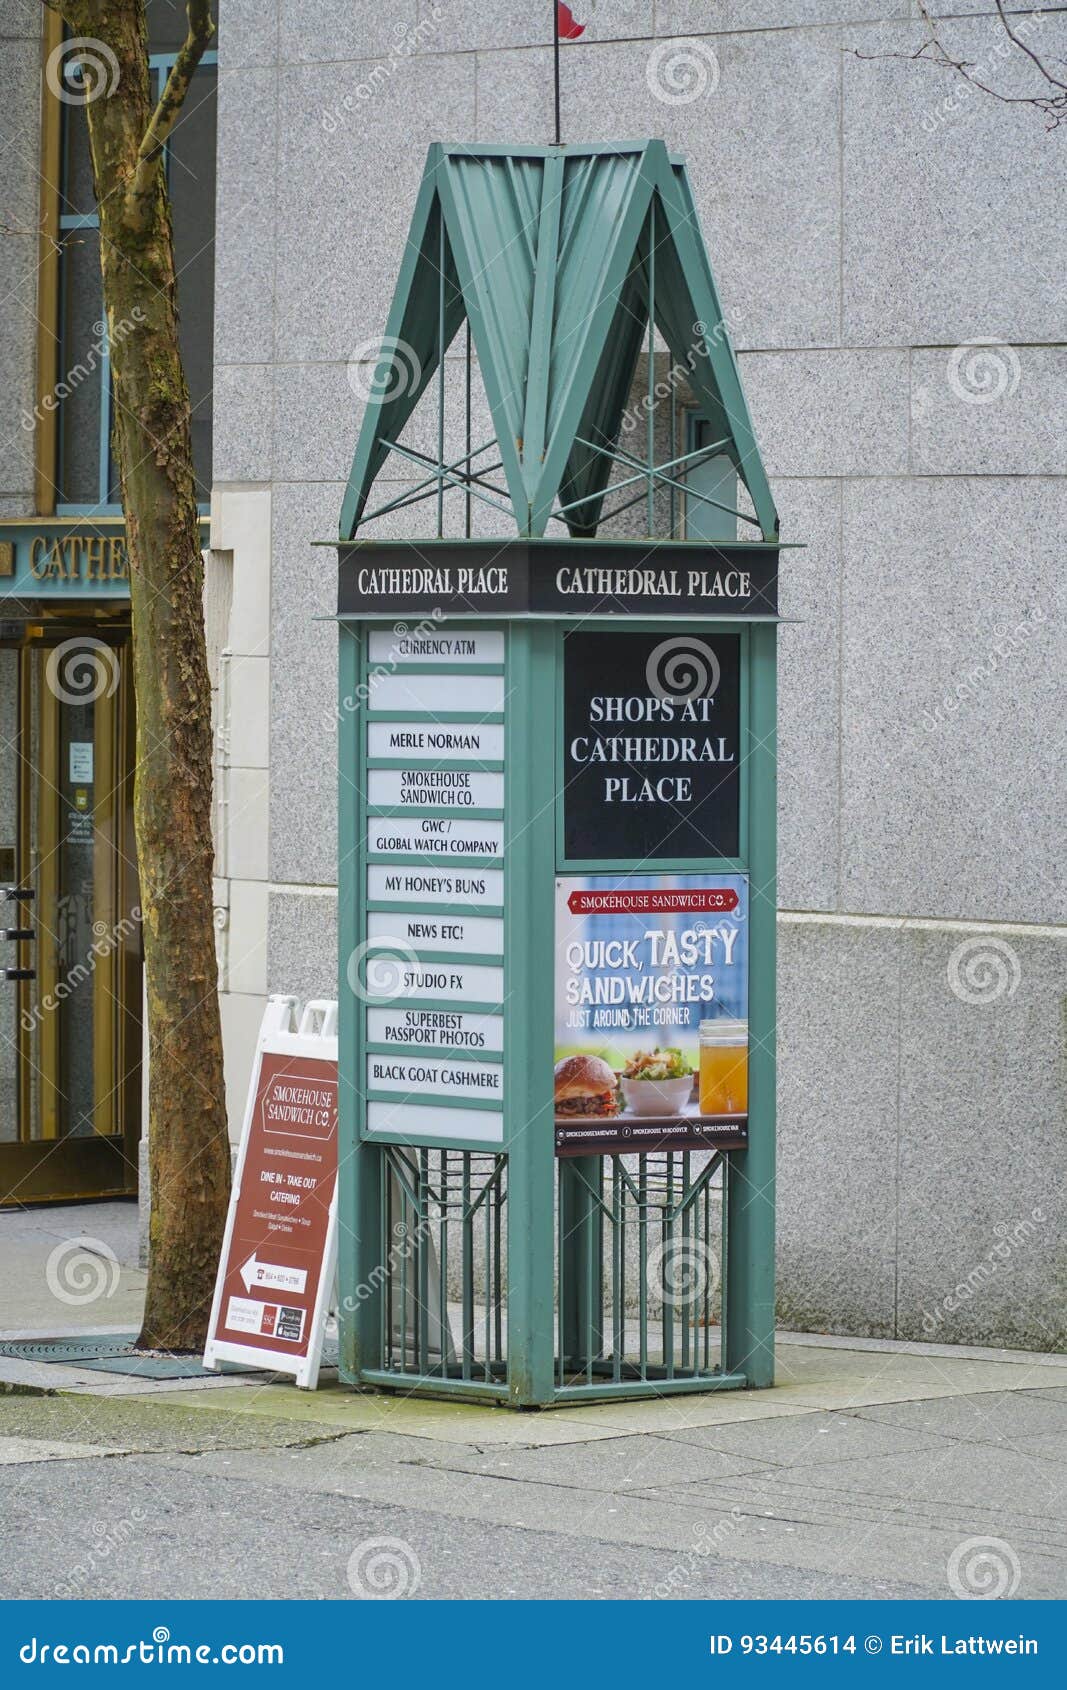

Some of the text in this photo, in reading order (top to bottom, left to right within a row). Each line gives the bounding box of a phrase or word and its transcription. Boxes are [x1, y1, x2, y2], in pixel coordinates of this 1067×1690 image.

[358, 568, 508, 594] CATHEDRAL PLACE
[556, 567, 751, 598] CATHEDRAL PLACE
[399, 640, 476, 655] CURRENCY ATM
[589, 696, 714, 722] SHOPS AT
[389, 733, 480, 749] MERLE NORMAN
[570, 736, 734, 762] CATHEDRAL
[401, 772, 470, 788] SMOKEHOUSE
[400, 789, 475, 806] SANDWICH CO.
[604, 777, 692, 802] PLACE
[421, 820, 452, 834] GWC /
[376, 837, 499, 853] GLOBAL WATCH COMPANY
[385, 876, 486, 894] MY HONEY'S BUNS
[580, 894, 727, 909] SMOKEHOUSE SANDWICH CO.
[407, 923, 464, 940] NEWS ETC!
[566, 928, 739, 974] QUICK, TASTY
[403, 972, 463, 989] STUDIO FX
[566, 974, 715, 1005] SANDWICHES
[405, 1011, 463, 1029] SUPERBEST
[566, 1007, 690, 1028] JUST AROUND THE CORNER
[385, 1026, 485, 1047] PASSPORT PHOTOS
[373, 1064, 500, 1088] BLACK GOAT CASHMERE
[272, 1085, 333, 1107] SMOKEHOUSE
[268, 1103, 330, 1128] SANDWICH CO.
[260, 1170, 275, 1183] DINE
[275, 1173, 283, 1184] IN
[287, 1175, 303, 1187] TAKE
[303, 1177, 317, 1188] OUT
[270, 1191, 301, 1205] CATERING
